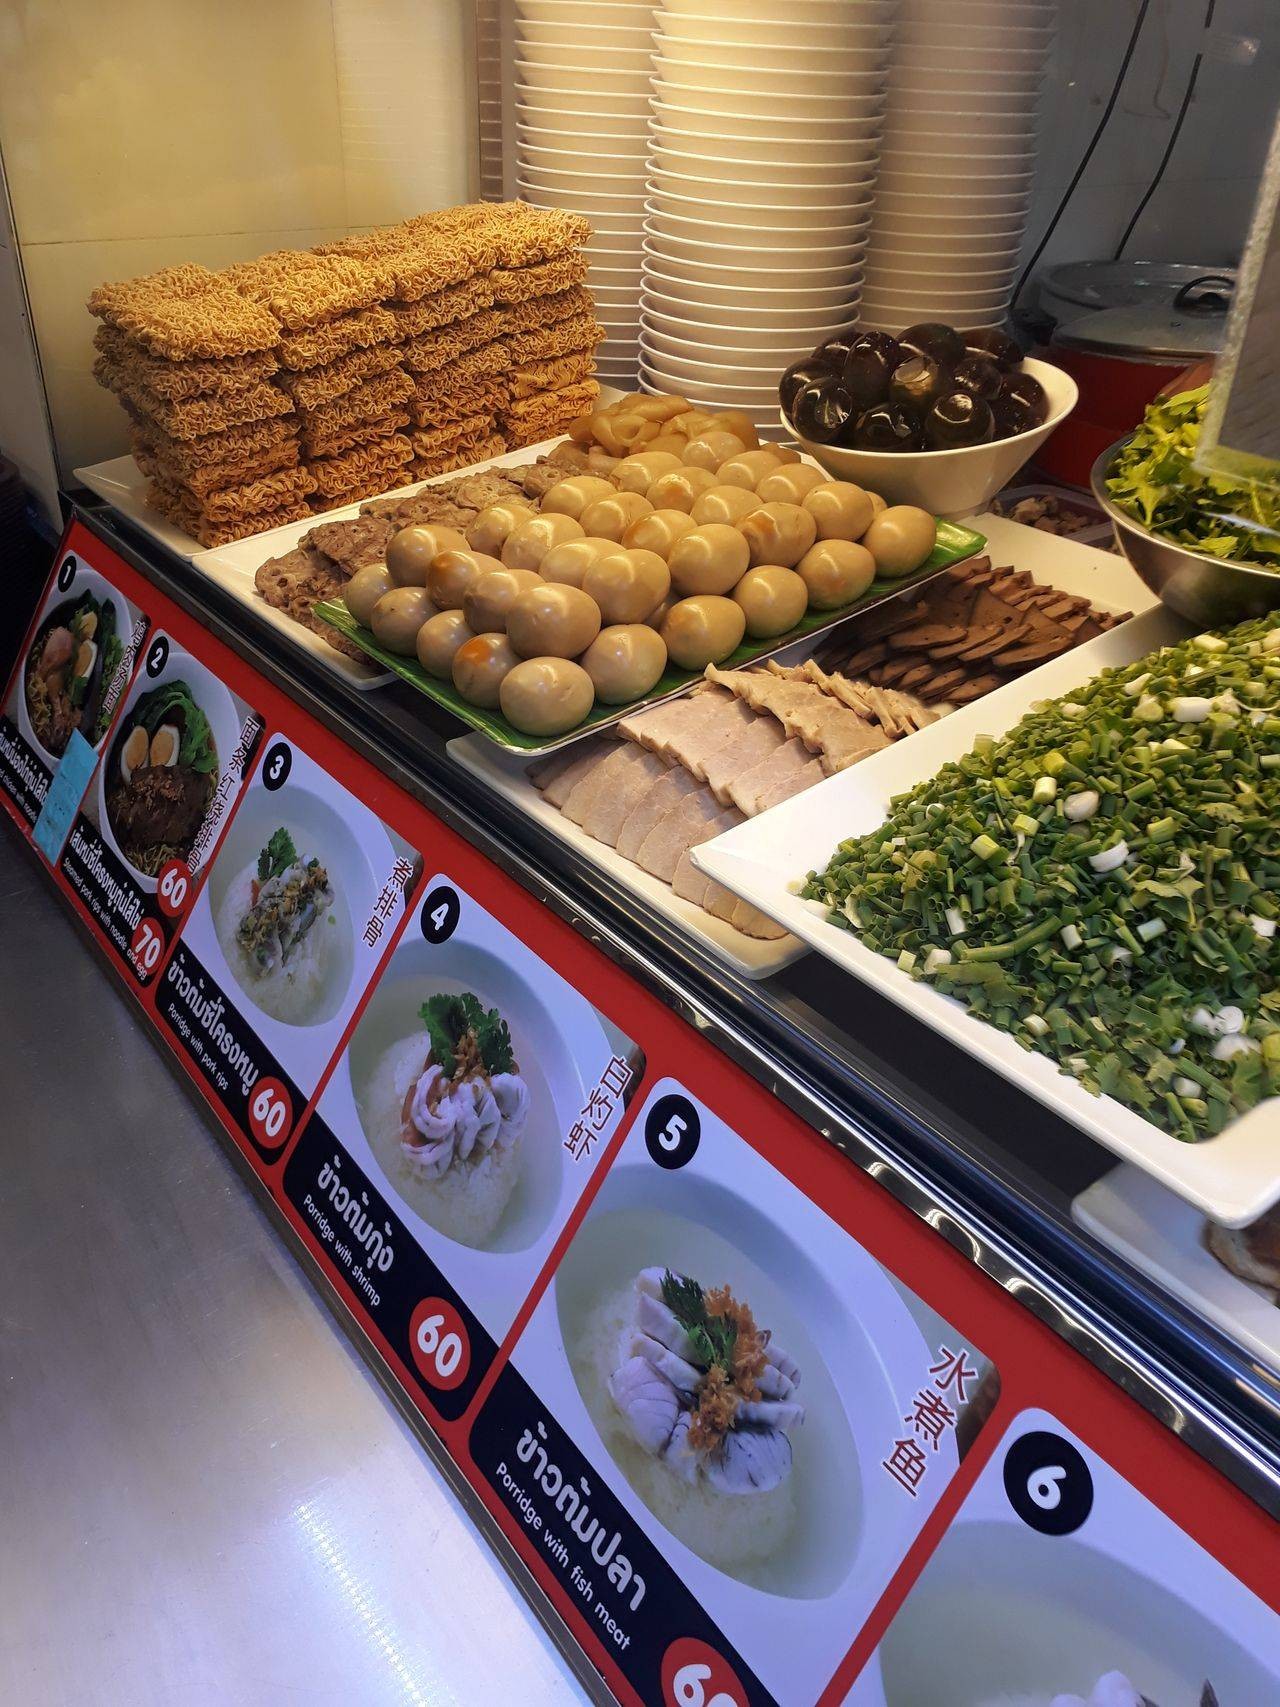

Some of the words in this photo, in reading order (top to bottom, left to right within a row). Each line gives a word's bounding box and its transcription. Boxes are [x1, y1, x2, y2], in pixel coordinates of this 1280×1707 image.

[62, 565, 72, 584] 1
[151, 647, 163, 669] 2
[269, 754, 284, 780] 3
[161, 868, 187, 908] 60
[362, 857, 414, 949] 煮排骨
[431, 902, 449, 931] 4
[80, 882, 92, 901] pork
[100, 909, 111, 928] with
[111, 924, 127, 950] noodle
[126, 948, 137, 964] and
[136, 961, 148, 981] egg
[135, 924, 160, 968] 70
[168, 953, 259, 1096] ข้าวต้มซี่โครงหมู
[168, 1003, 191, 1038] Porridge
[190, 1035, 204, 1056] with
[202, 1053, 216, 1078] pork
[215, 1071, 229, 1091] rips
[253, 1088, 286, 1137] 60
[564, 1056, 634, 1161] 白灼虾
[658, 1114, 688, 1151] 5
[303, 1194, 335, 1242] Porridge
[334, 1238, 352, 1268] with
[351, 1265, 381, 1307] shrimp
[317, 1154, 394, 1272] ข้าวต้มกุ้ง
[417, 1314, 462, 1377] 60
[882, 1347, 976, 1498] 水煮鱼
[516, 1421, 646, 1611] ข้าวต้มปลา
[1026, 1465, 1066, 1510] 6
[495, 1462, 543, 1530] Porridge
[543, 1529, 569, 1568] with
[570, 1565, 594, 1602] fish
[594, 1601, 631, 1650] meat
